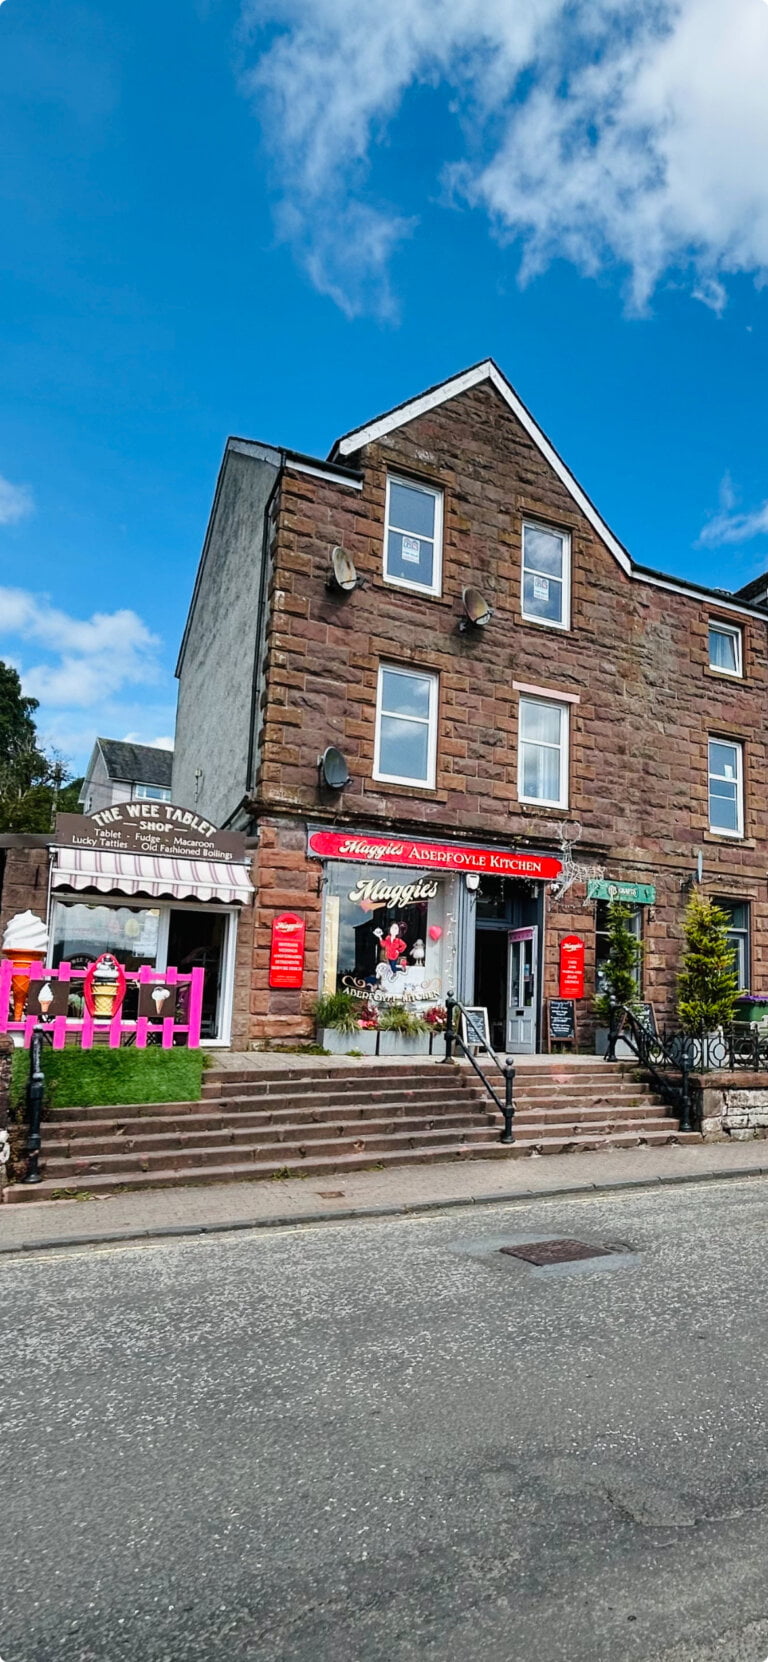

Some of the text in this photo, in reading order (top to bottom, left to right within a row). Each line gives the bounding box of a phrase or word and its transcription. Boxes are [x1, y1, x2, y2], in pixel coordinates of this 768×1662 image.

[91, 804, 217, 838] THE WEE TABLET
[139, 820, 174, 832] SHOP
[72, 835, 97, 847] Lucky
[99, 838, 128, 848] Tatties
[141, 842, 158, 851] Old
[160, 844, 201, 856] Fashioned
[202, 848, 233, 860] Boilings
[94, 828, 122, 839] Tablet
[135, 832, 161, 844] Fudge
[173, 837, 215, 848] Macaroon
[408, 845, 486, 866] ABERFOYLE
[490, 855, 542, 872] KITCHEN
